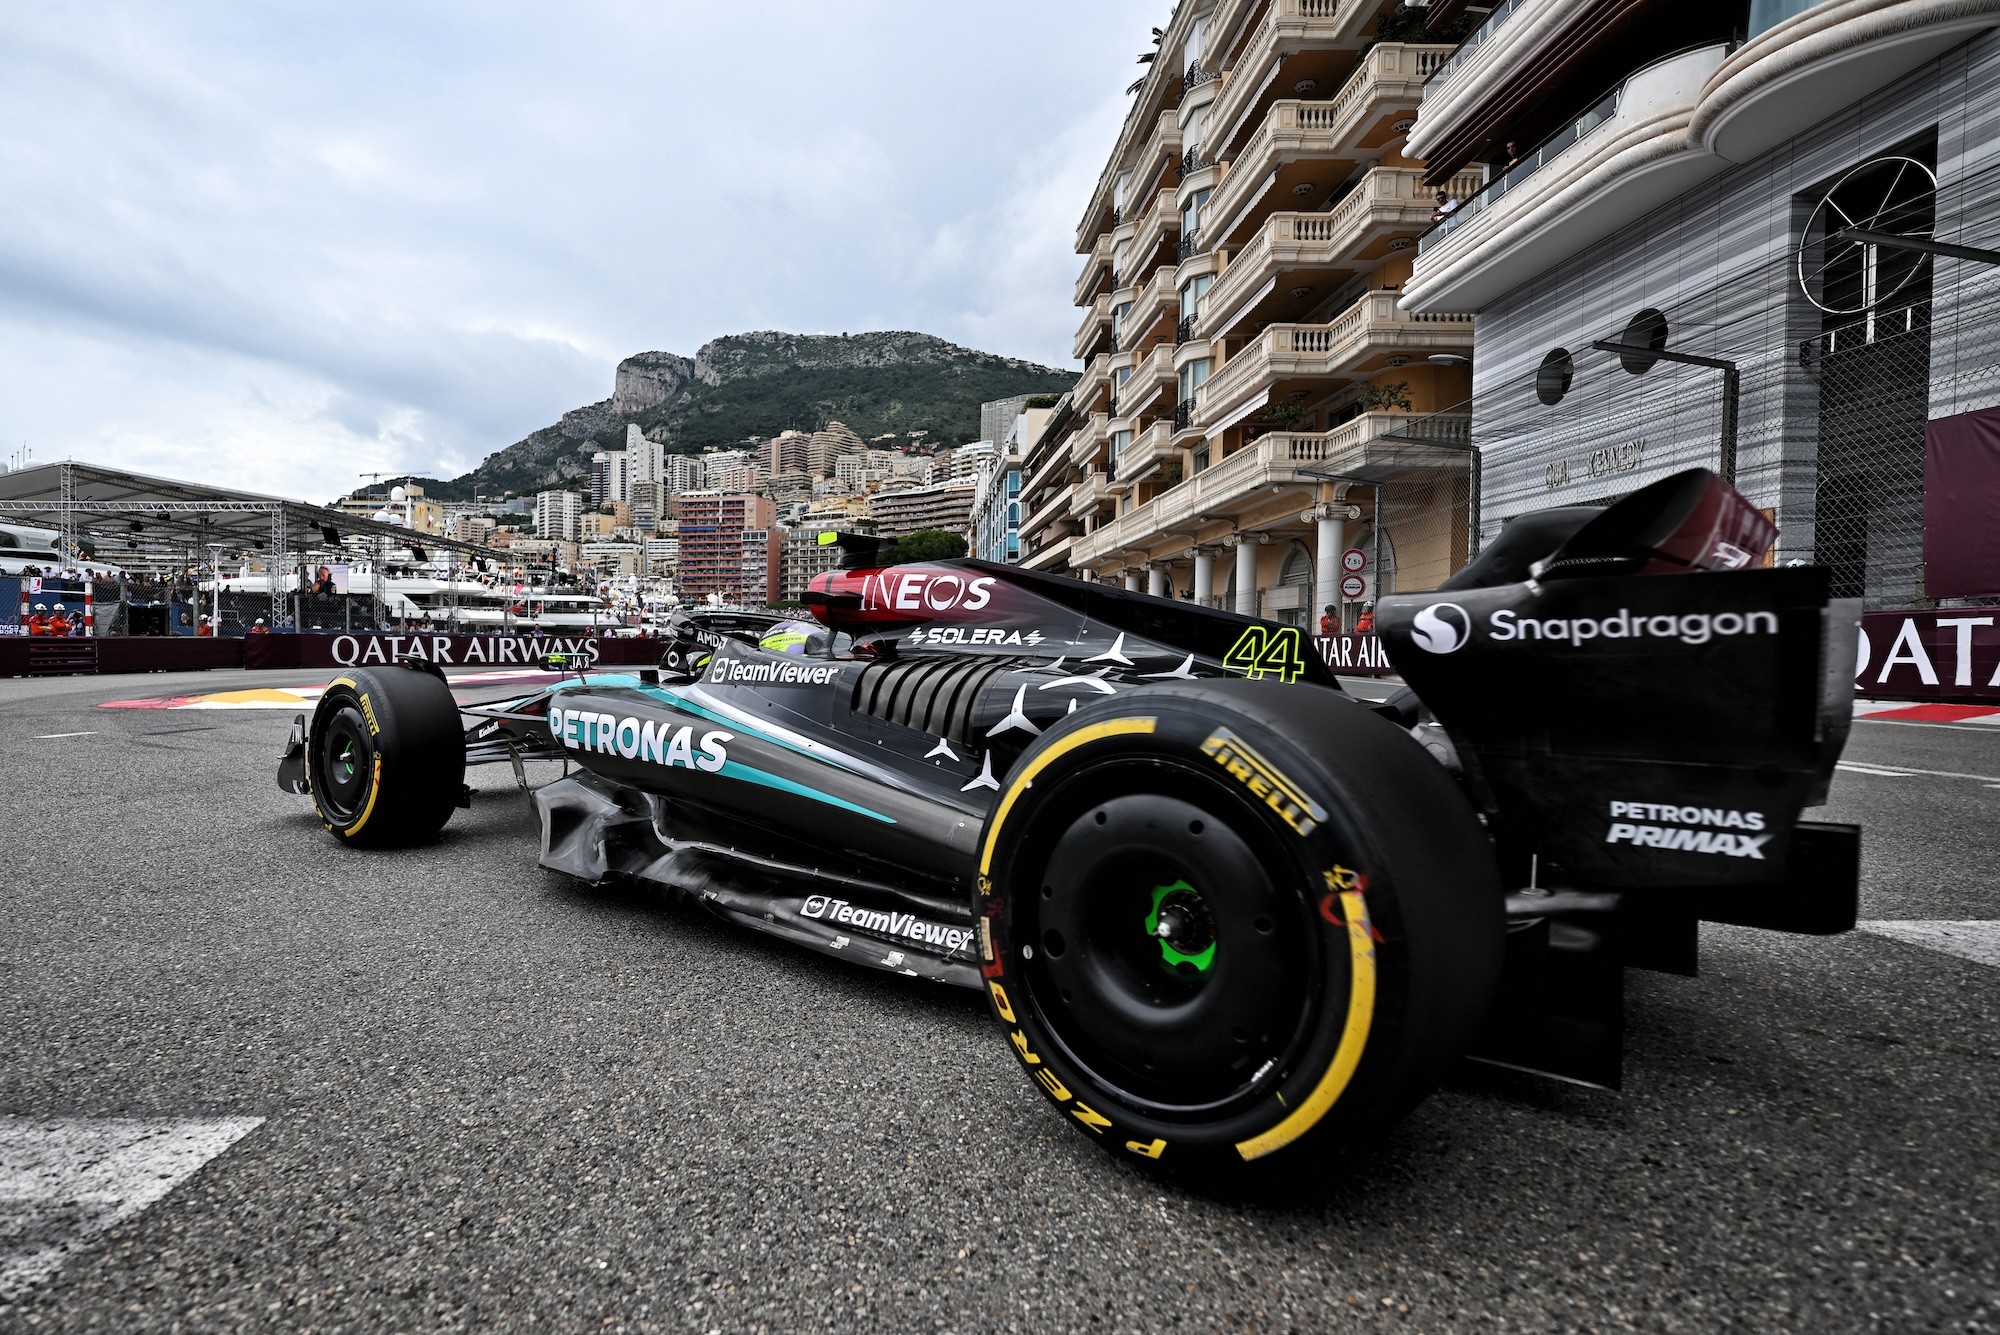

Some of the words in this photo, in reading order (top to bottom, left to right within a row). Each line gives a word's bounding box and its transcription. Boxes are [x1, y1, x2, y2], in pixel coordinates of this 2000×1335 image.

[1588, 438, 1646, 478] KENNEDY
[859, 573, 997, 611] INEOS
[696, 630, 720, 648] AMD
[924, 627, 1023, 646] SOLERA
[1489, 598, 1779, 647] Snapdragon
[331, 635, 454, 667] QATAR
[463, 636, 600, 664] AIRWAYS
[1222, 625, 1305, 685] 44
[1313, 635, 1353, 668] TAR
[1854, 616, 2000, 690] AT
[728, 660, 839, 685] TeamViewer
[360, 692, 381, 737] PIRELLI
[550, 707, 735, 773] PETRONAS
[1200, 726, 1329, 838] PIRELLI
[1609, 800, 1766, 831] PETRONAS
[1605, 822, 1776, 860] PRIMAX
[829, 899, 975, 951] TeamViewer
[988, 979, 1113, 1135] ZERO
[1125, 1138, 1168, 1160] P
